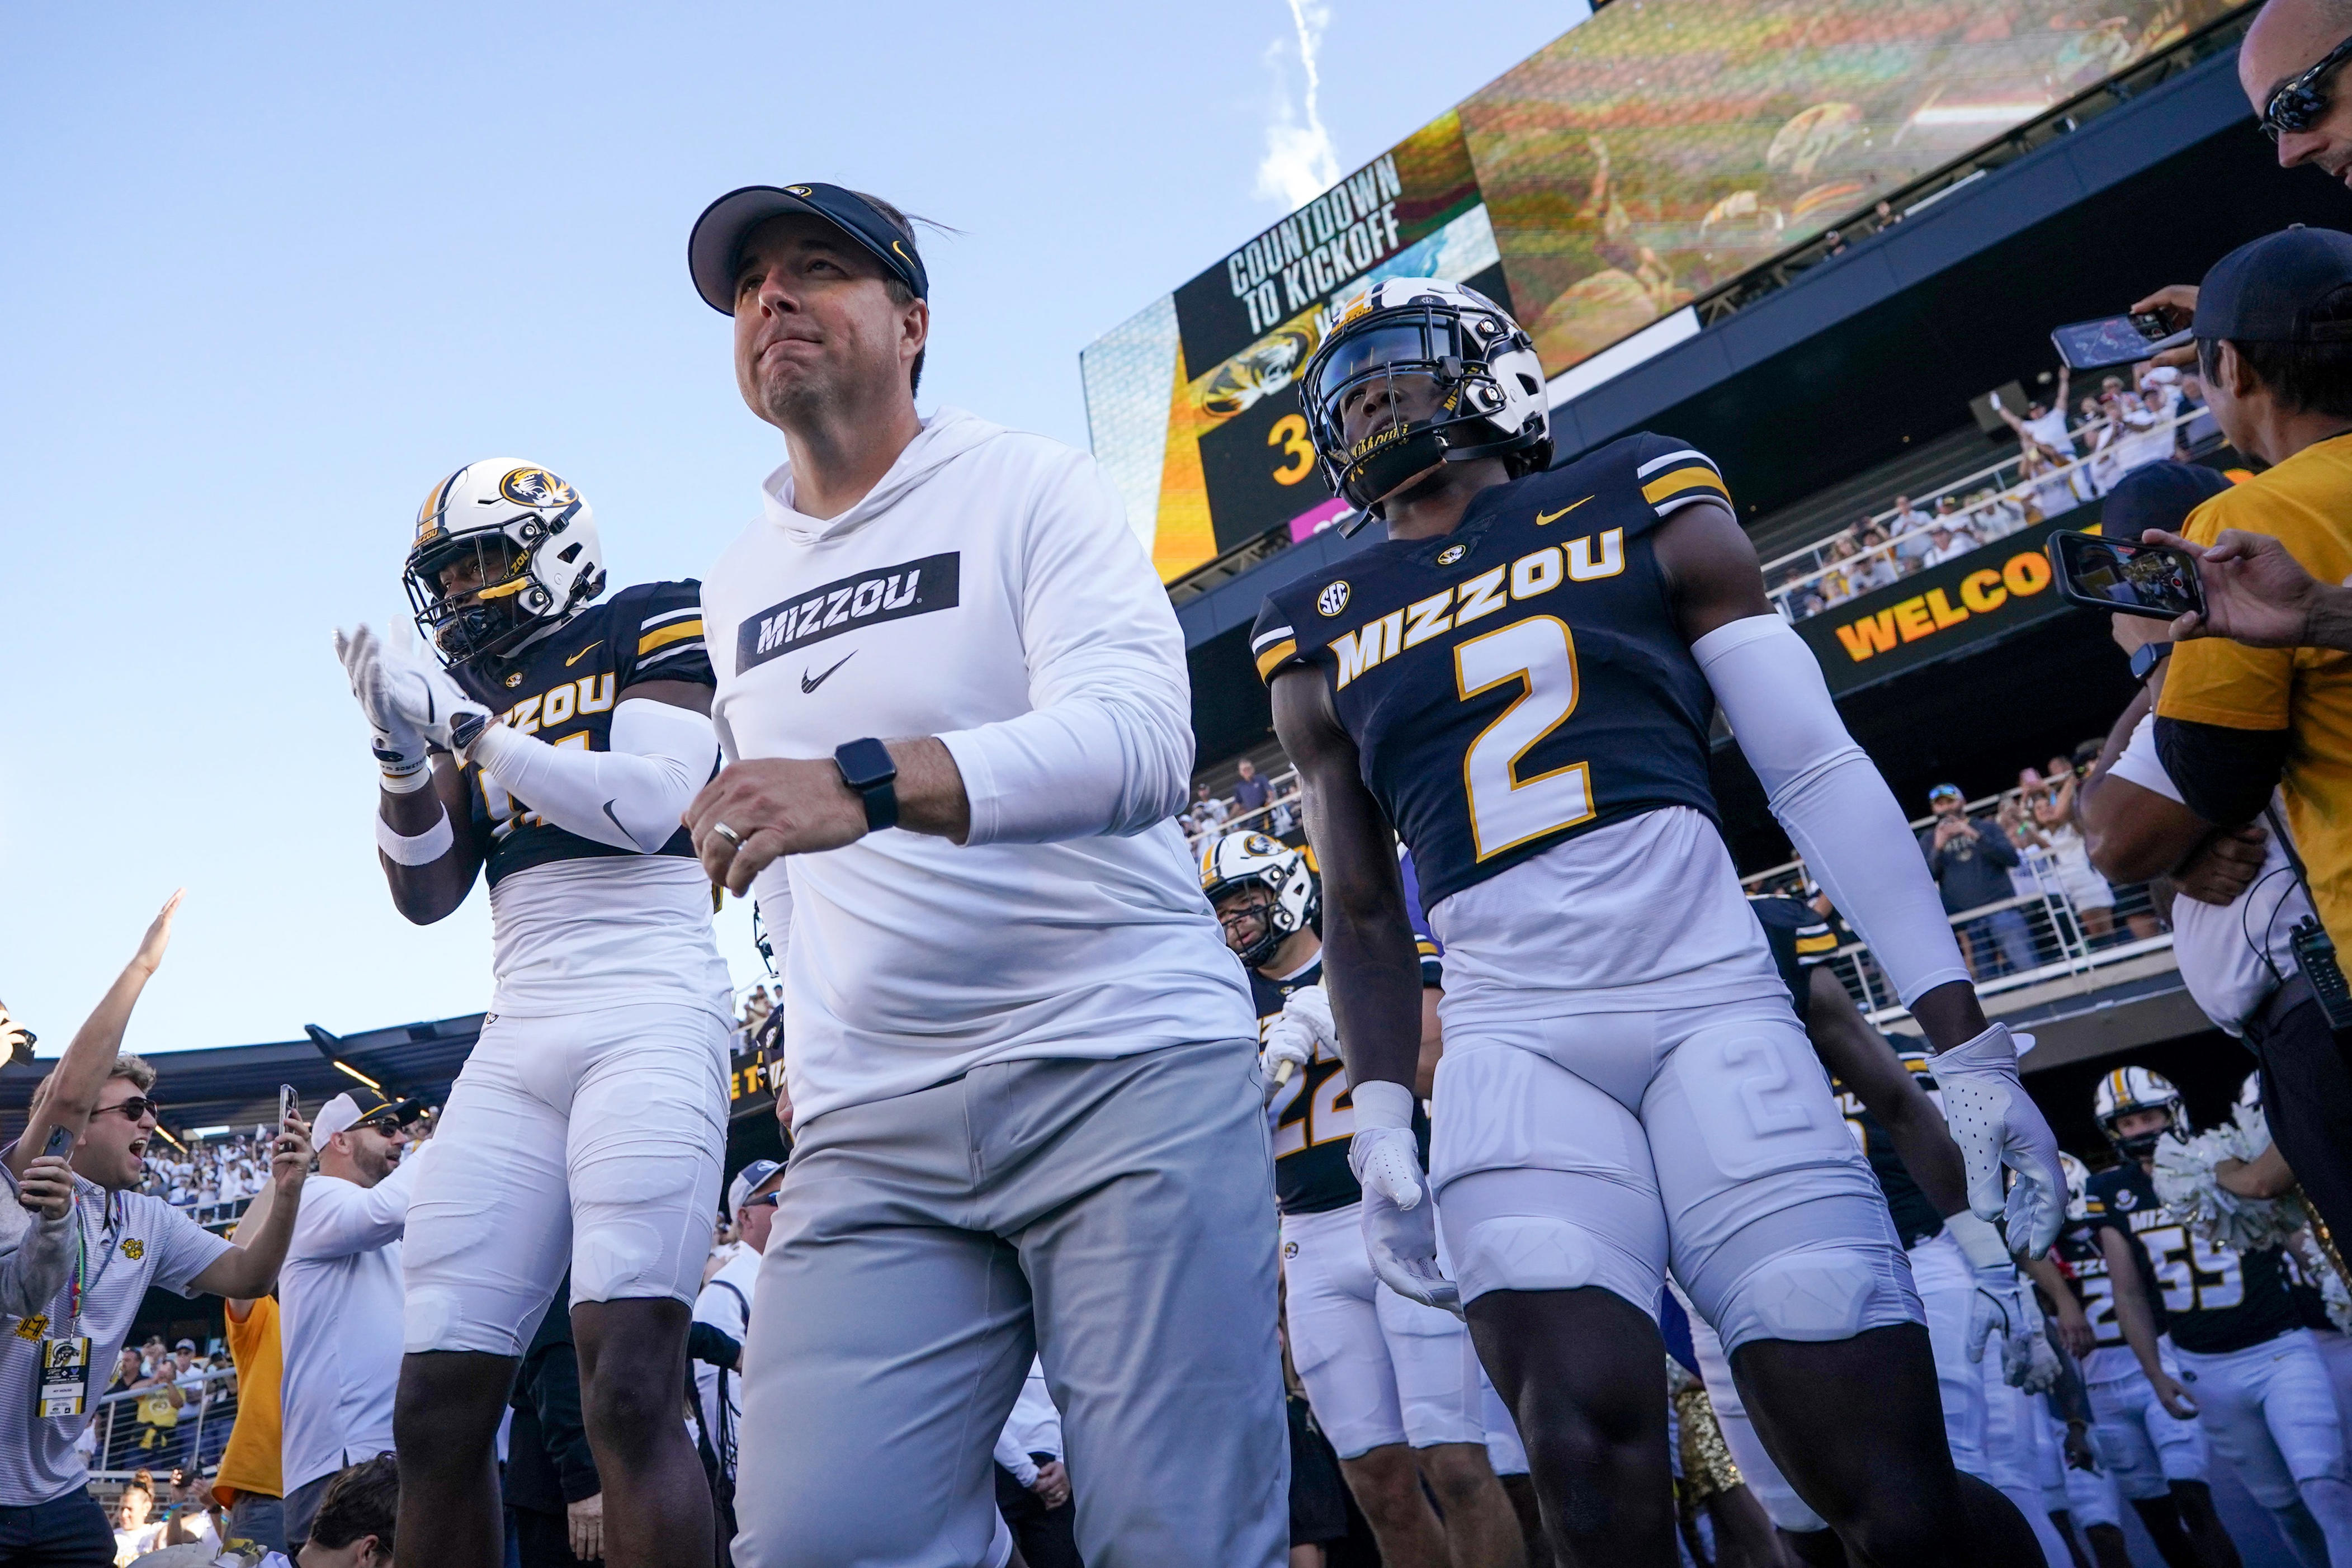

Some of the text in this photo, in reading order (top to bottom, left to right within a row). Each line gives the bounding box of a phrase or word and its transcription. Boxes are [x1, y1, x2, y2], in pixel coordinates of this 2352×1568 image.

[1227, 153, 1401, 297] COUNTDOWN
[1243, 201, 1399, 334] TO KICKOFF
[1331, 305, 1374, 336] MIZZOU
[1268, 414, 1315, 486] 3
[757, 569, 921, 654] MIZZOU
[1319, 582, 1348, 615] SEC
[1327, 526, 1626, 692] MIZZOU
[1836, 523, 2101, 662] WELCO
[1453, 614, 1597, 864] 2
